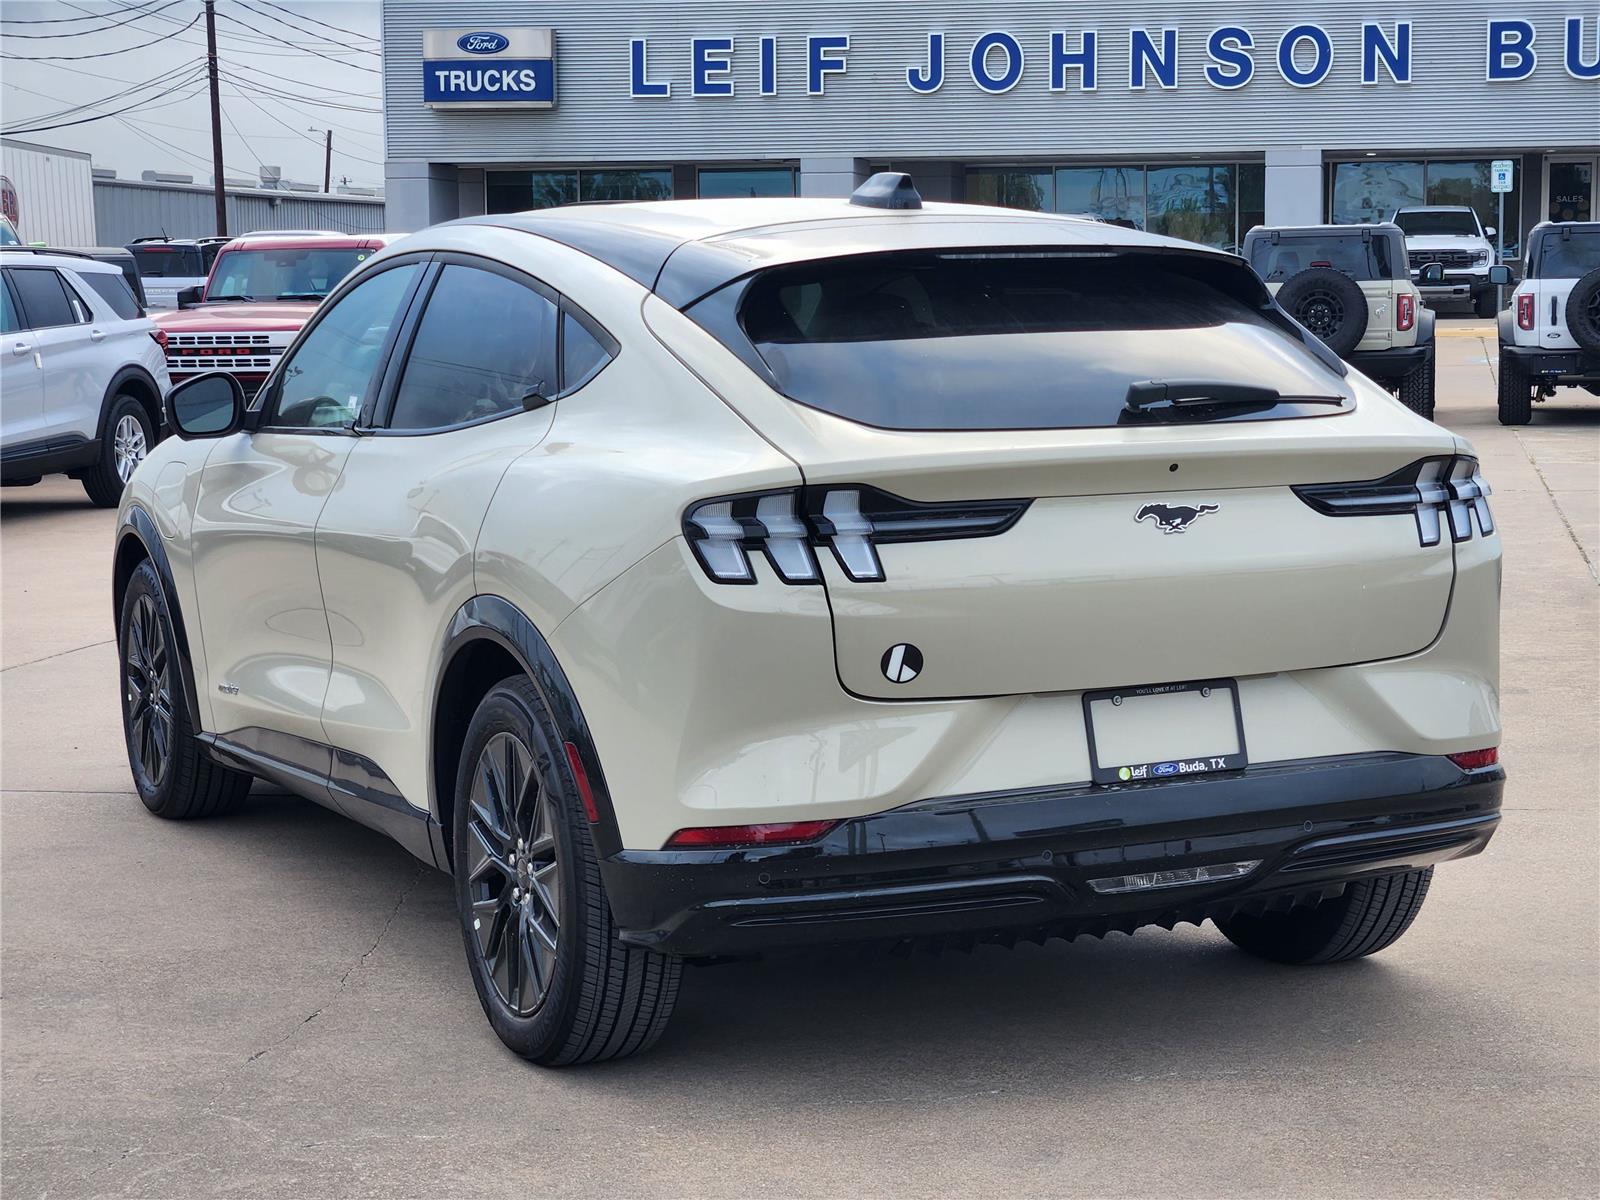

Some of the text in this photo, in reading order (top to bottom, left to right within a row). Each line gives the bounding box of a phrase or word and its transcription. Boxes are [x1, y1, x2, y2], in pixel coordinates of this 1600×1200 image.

[466, 35, 498, 50] Ford
[629, 17, 1600, 98] LEIF JOHNSON BU
[435, 69, 536, 92] TRUCKS
[1555, 195, 1584, 203] SALES
[1157, 765, 1174, 774] Ford
[1179, 761, 1208, 773] Buda,
[1209, 757, 1226, 769] TX
